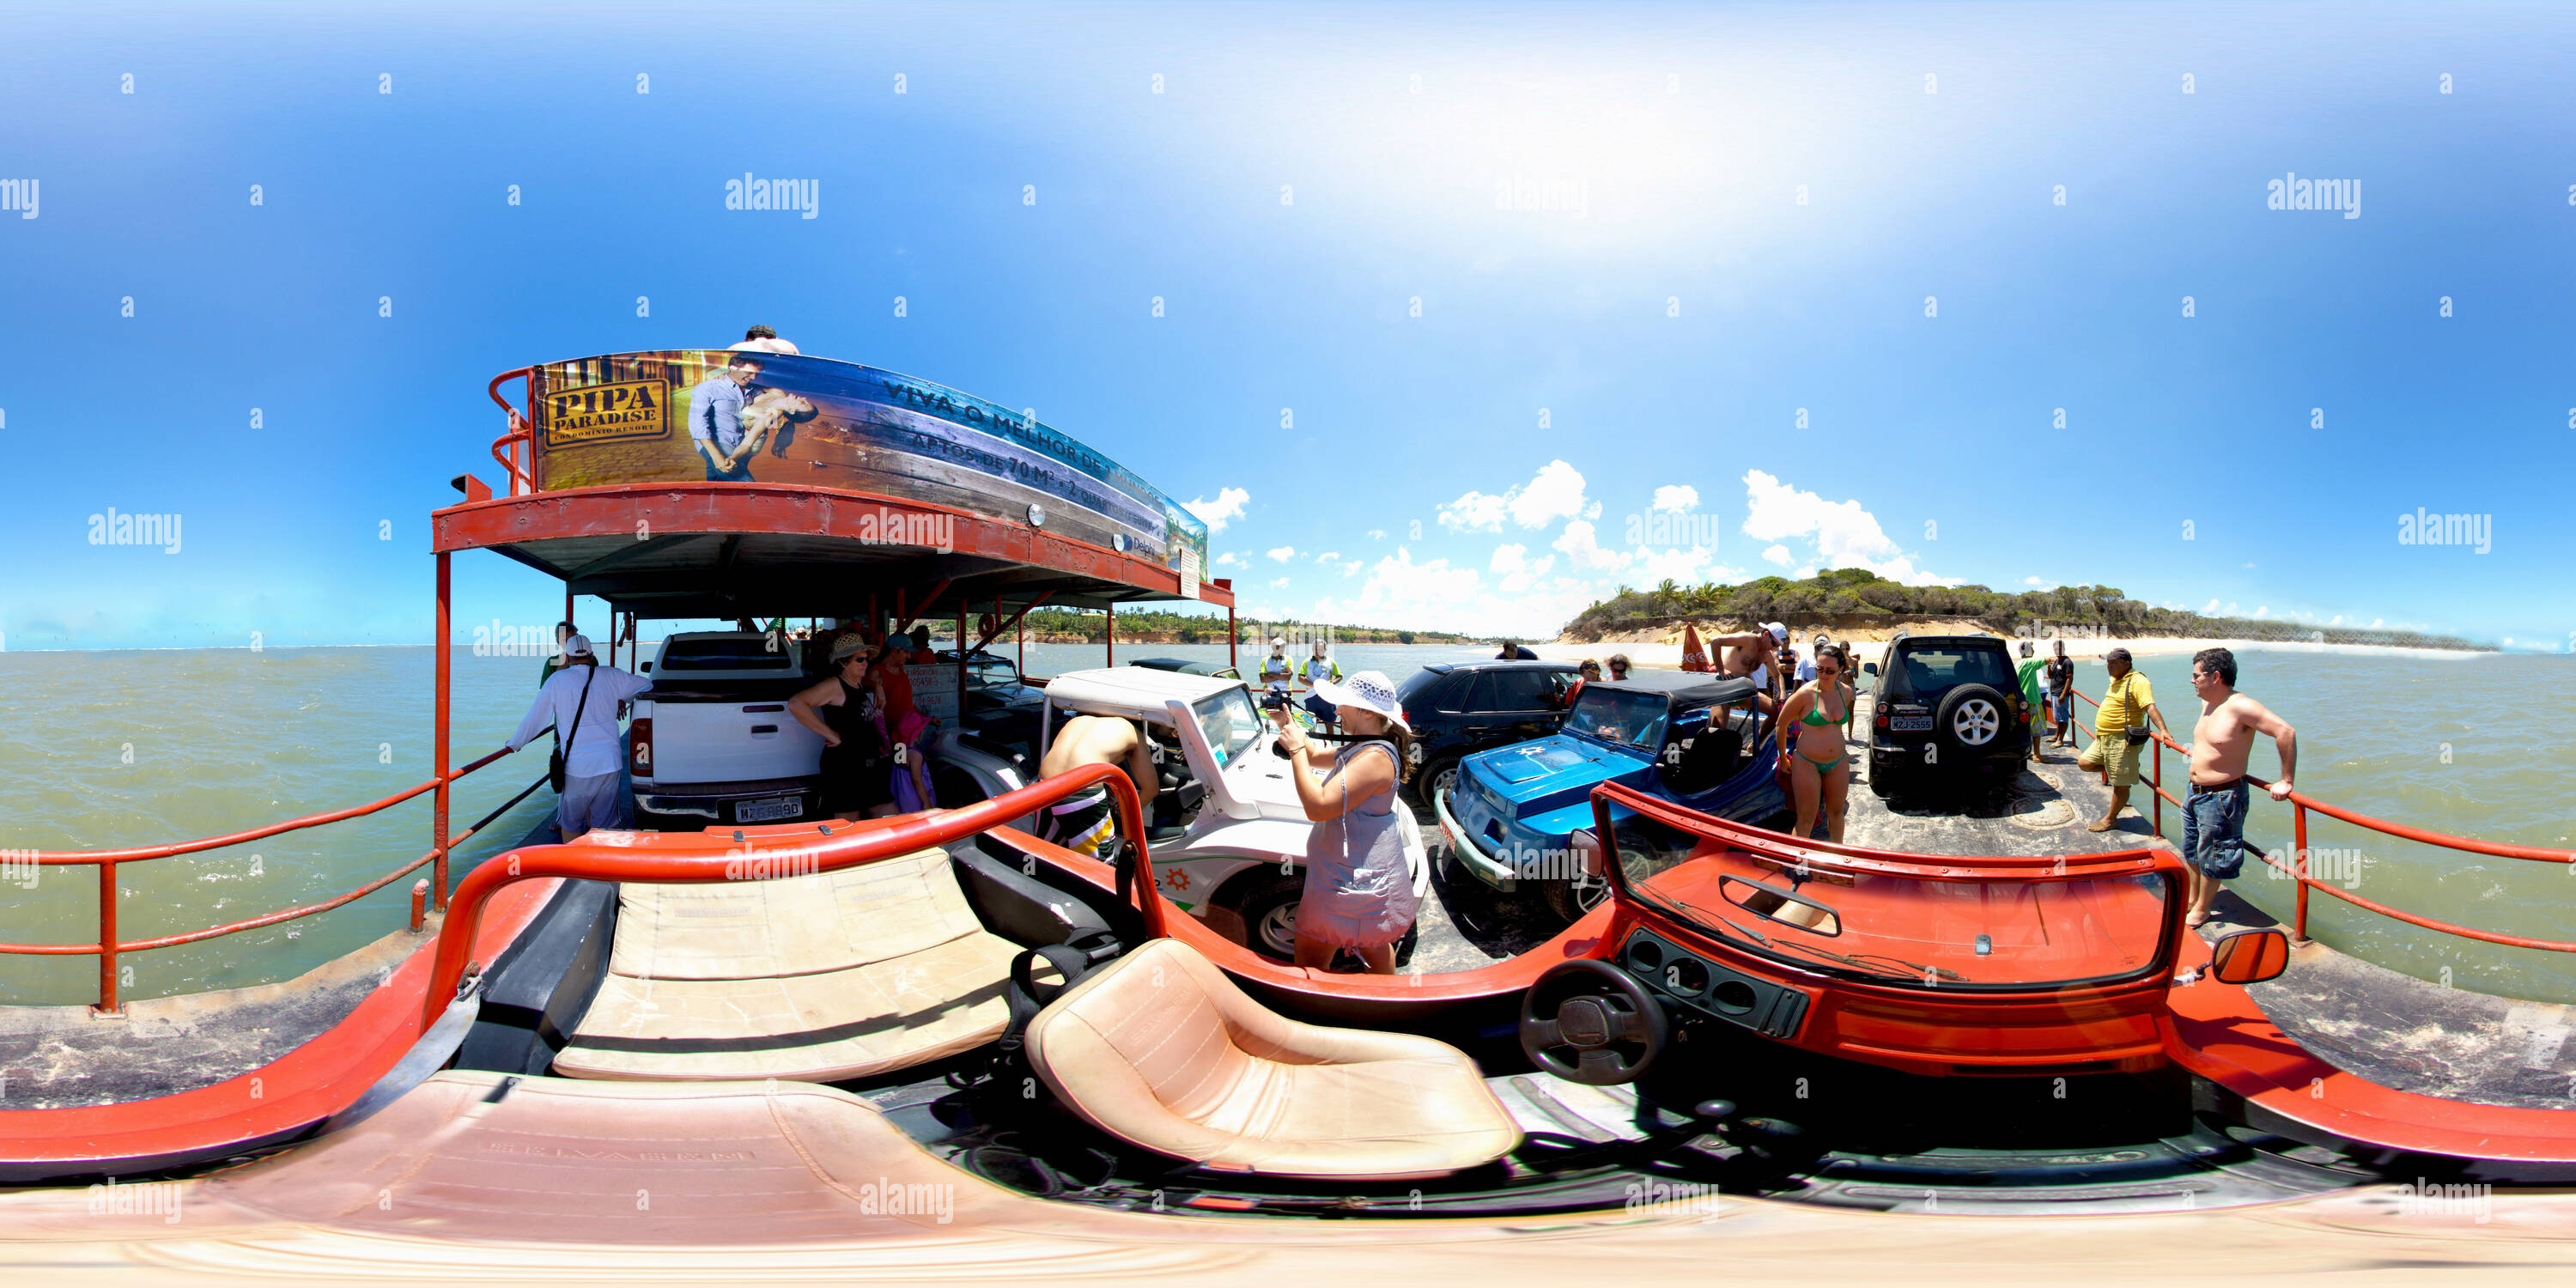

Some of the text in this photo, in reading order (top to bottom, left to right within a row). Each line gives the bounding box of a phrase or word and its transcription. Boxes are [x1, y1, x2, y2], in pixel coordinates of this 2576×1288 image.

[554, 386, 657, 419] PIPA
[555, 410, 656, 431] PARADISE
[616, 424, 655, 434] RESORT
[883, 380, 955, 414] VIVA
[964, 405, 984, 422] O
[993, 413, 1078, 462] MELHOR
[1082, 453, 1101, 472] DE
[983, 453, 1005, 471] DE
[1008, 457, 1030, 478] 70
[1069, 480, 1077, 496] 2
[1081, 490, 1124, 517] QUARTOS
[1134, 538, 1155, 556] Delphi
